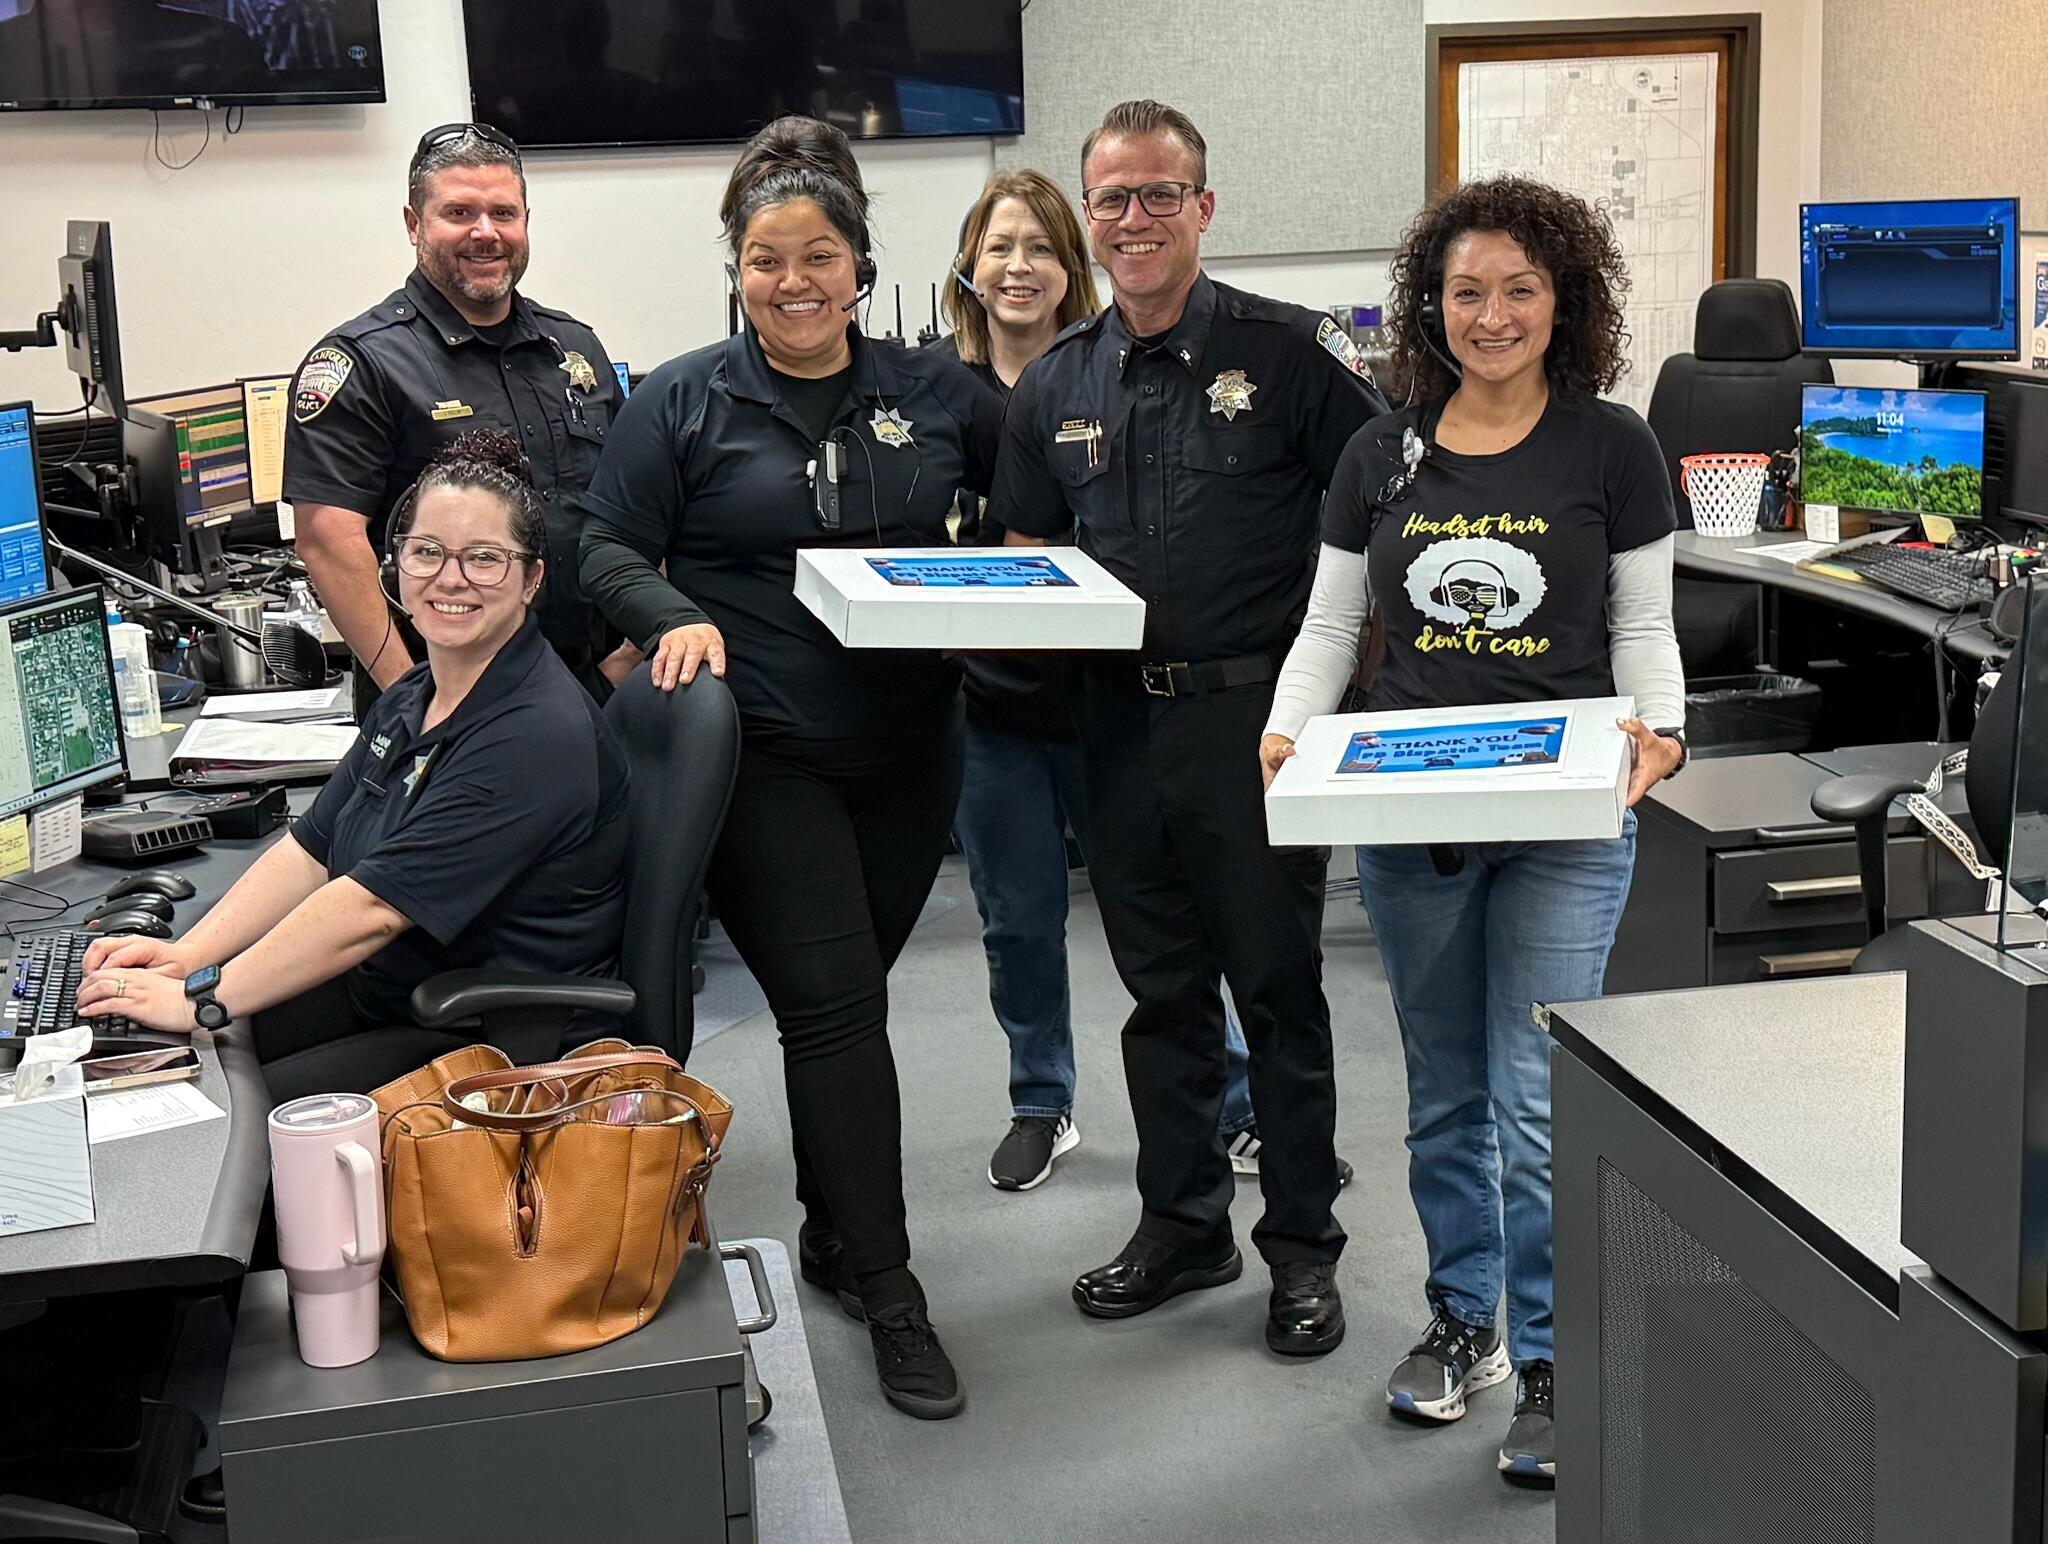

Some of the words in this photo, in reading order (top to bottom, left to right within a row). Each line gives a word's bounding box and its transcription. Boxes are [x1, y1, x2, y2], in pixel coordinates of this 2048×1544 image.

[1876, 411, 1904, 427] 11:04
[1402, 512, 1495, 538] Headset
[1498, 512, 1549, 535] hair
[980, 565, 1021, 573] YOU
[1414, 625, 1494, 655] don't
[1489, 636, 1550, 658] care
[1391, 738, 1466, 749] THANK
[1472, 734, 1519, 744] YOU
[1393, 745, 1480, 758] Dispatch
[1487, 742, 1543, 752] Team
